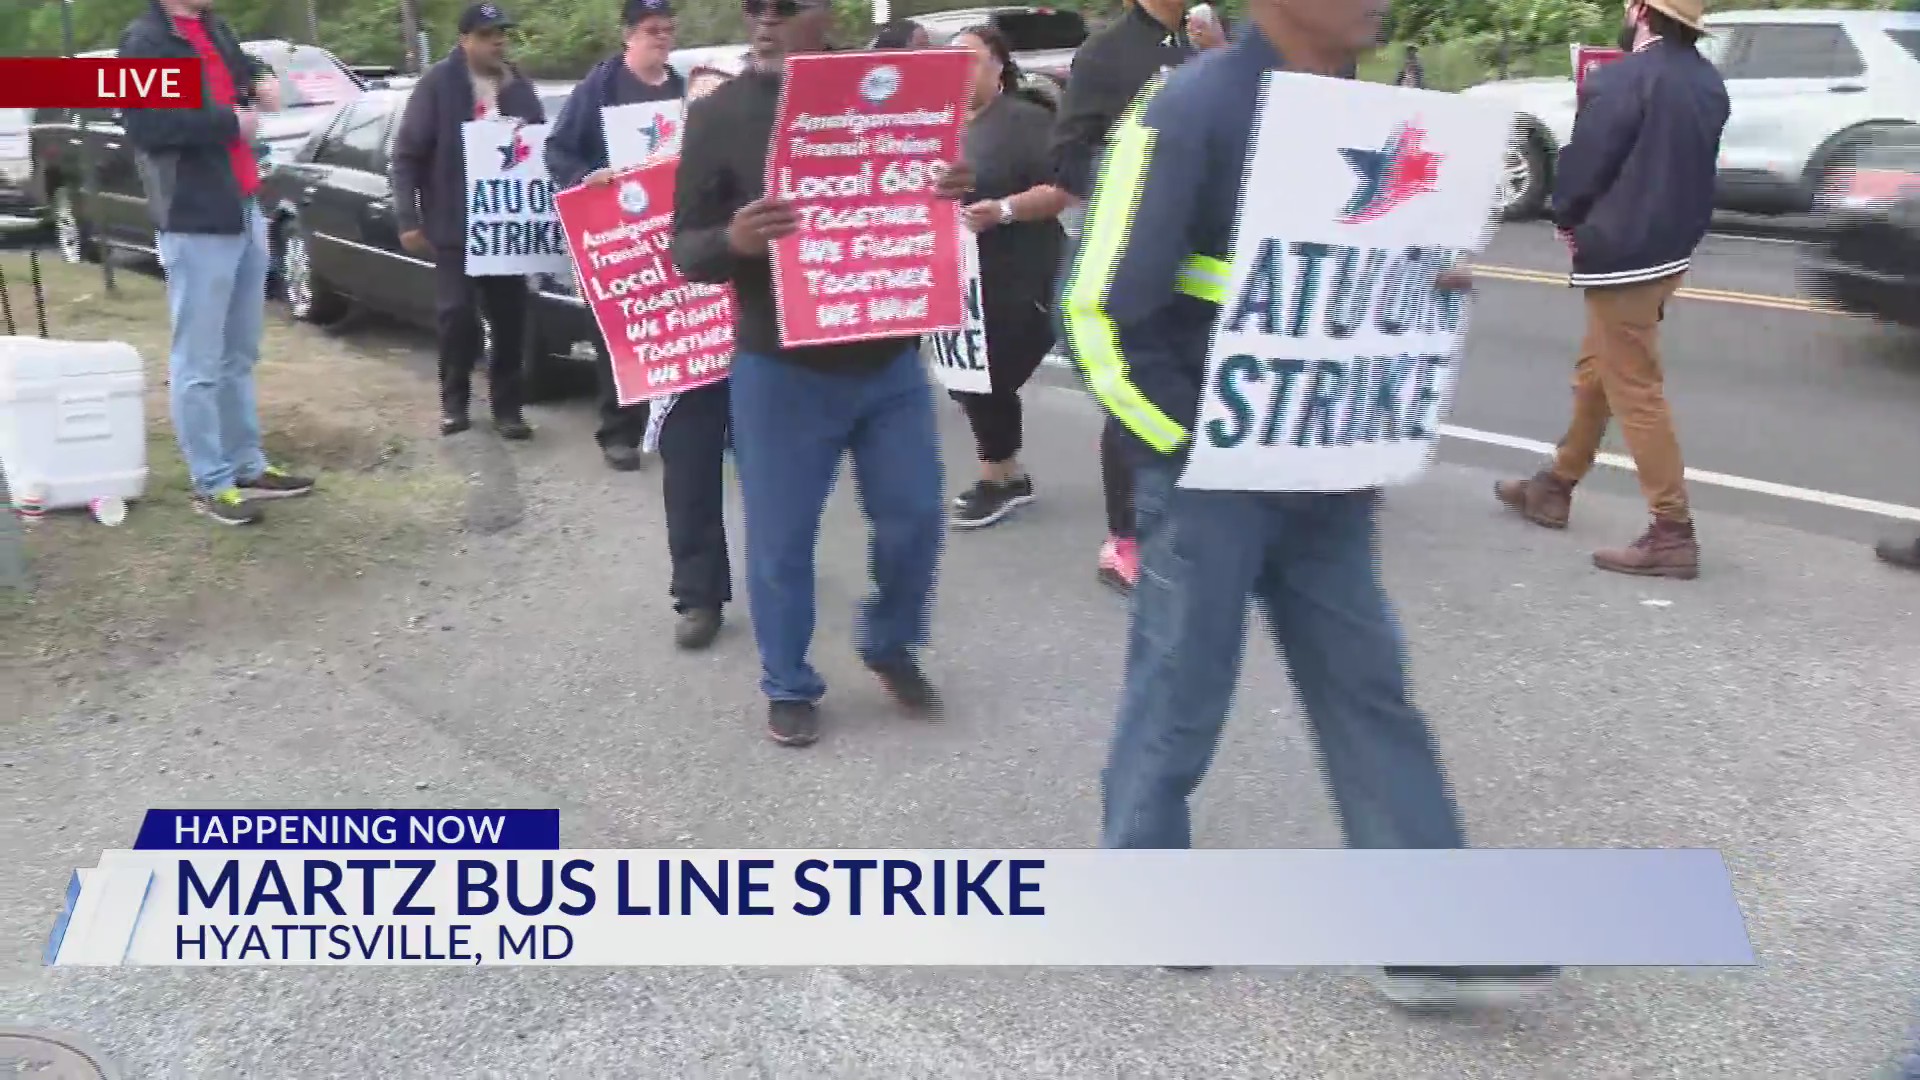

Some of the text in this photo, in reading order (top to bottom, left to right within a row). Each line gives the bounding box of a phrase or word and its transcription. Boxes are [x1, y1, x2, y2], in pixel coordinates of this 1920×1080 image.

[789, 102, 953, 133] Amalgamated
[790, 133, 942, 158] Transit Union
[472, 178, 521, 214] ATU
[777, 160, 874, 200] Local
[587, 238, 653, 269] Transit
[591, 255, 668, 301] Local
[1226, 237, 1386, 338] ATU
[1205, 352, 1446, 449] STRIKE
